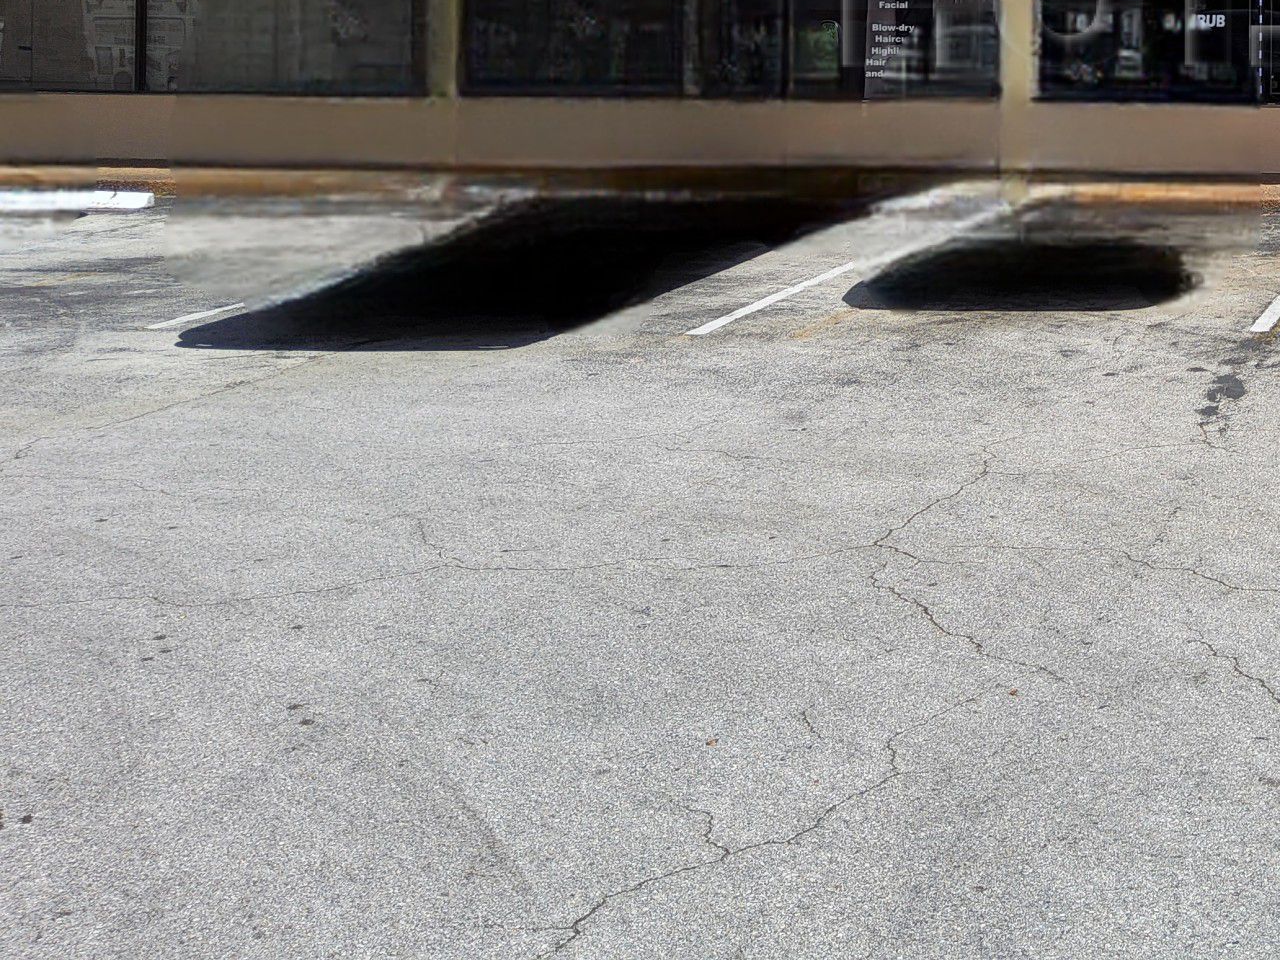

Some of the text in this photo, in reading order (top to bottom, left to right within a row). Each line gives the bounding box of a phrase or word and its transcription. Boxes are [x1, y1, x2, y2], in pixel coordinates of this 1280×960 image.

[879, 1, 909, 9] Facial
[872, 24, 915, 33] Blow-dry
[871, 47, 901, 56] Highli
[865, 70, 884, 78] and
